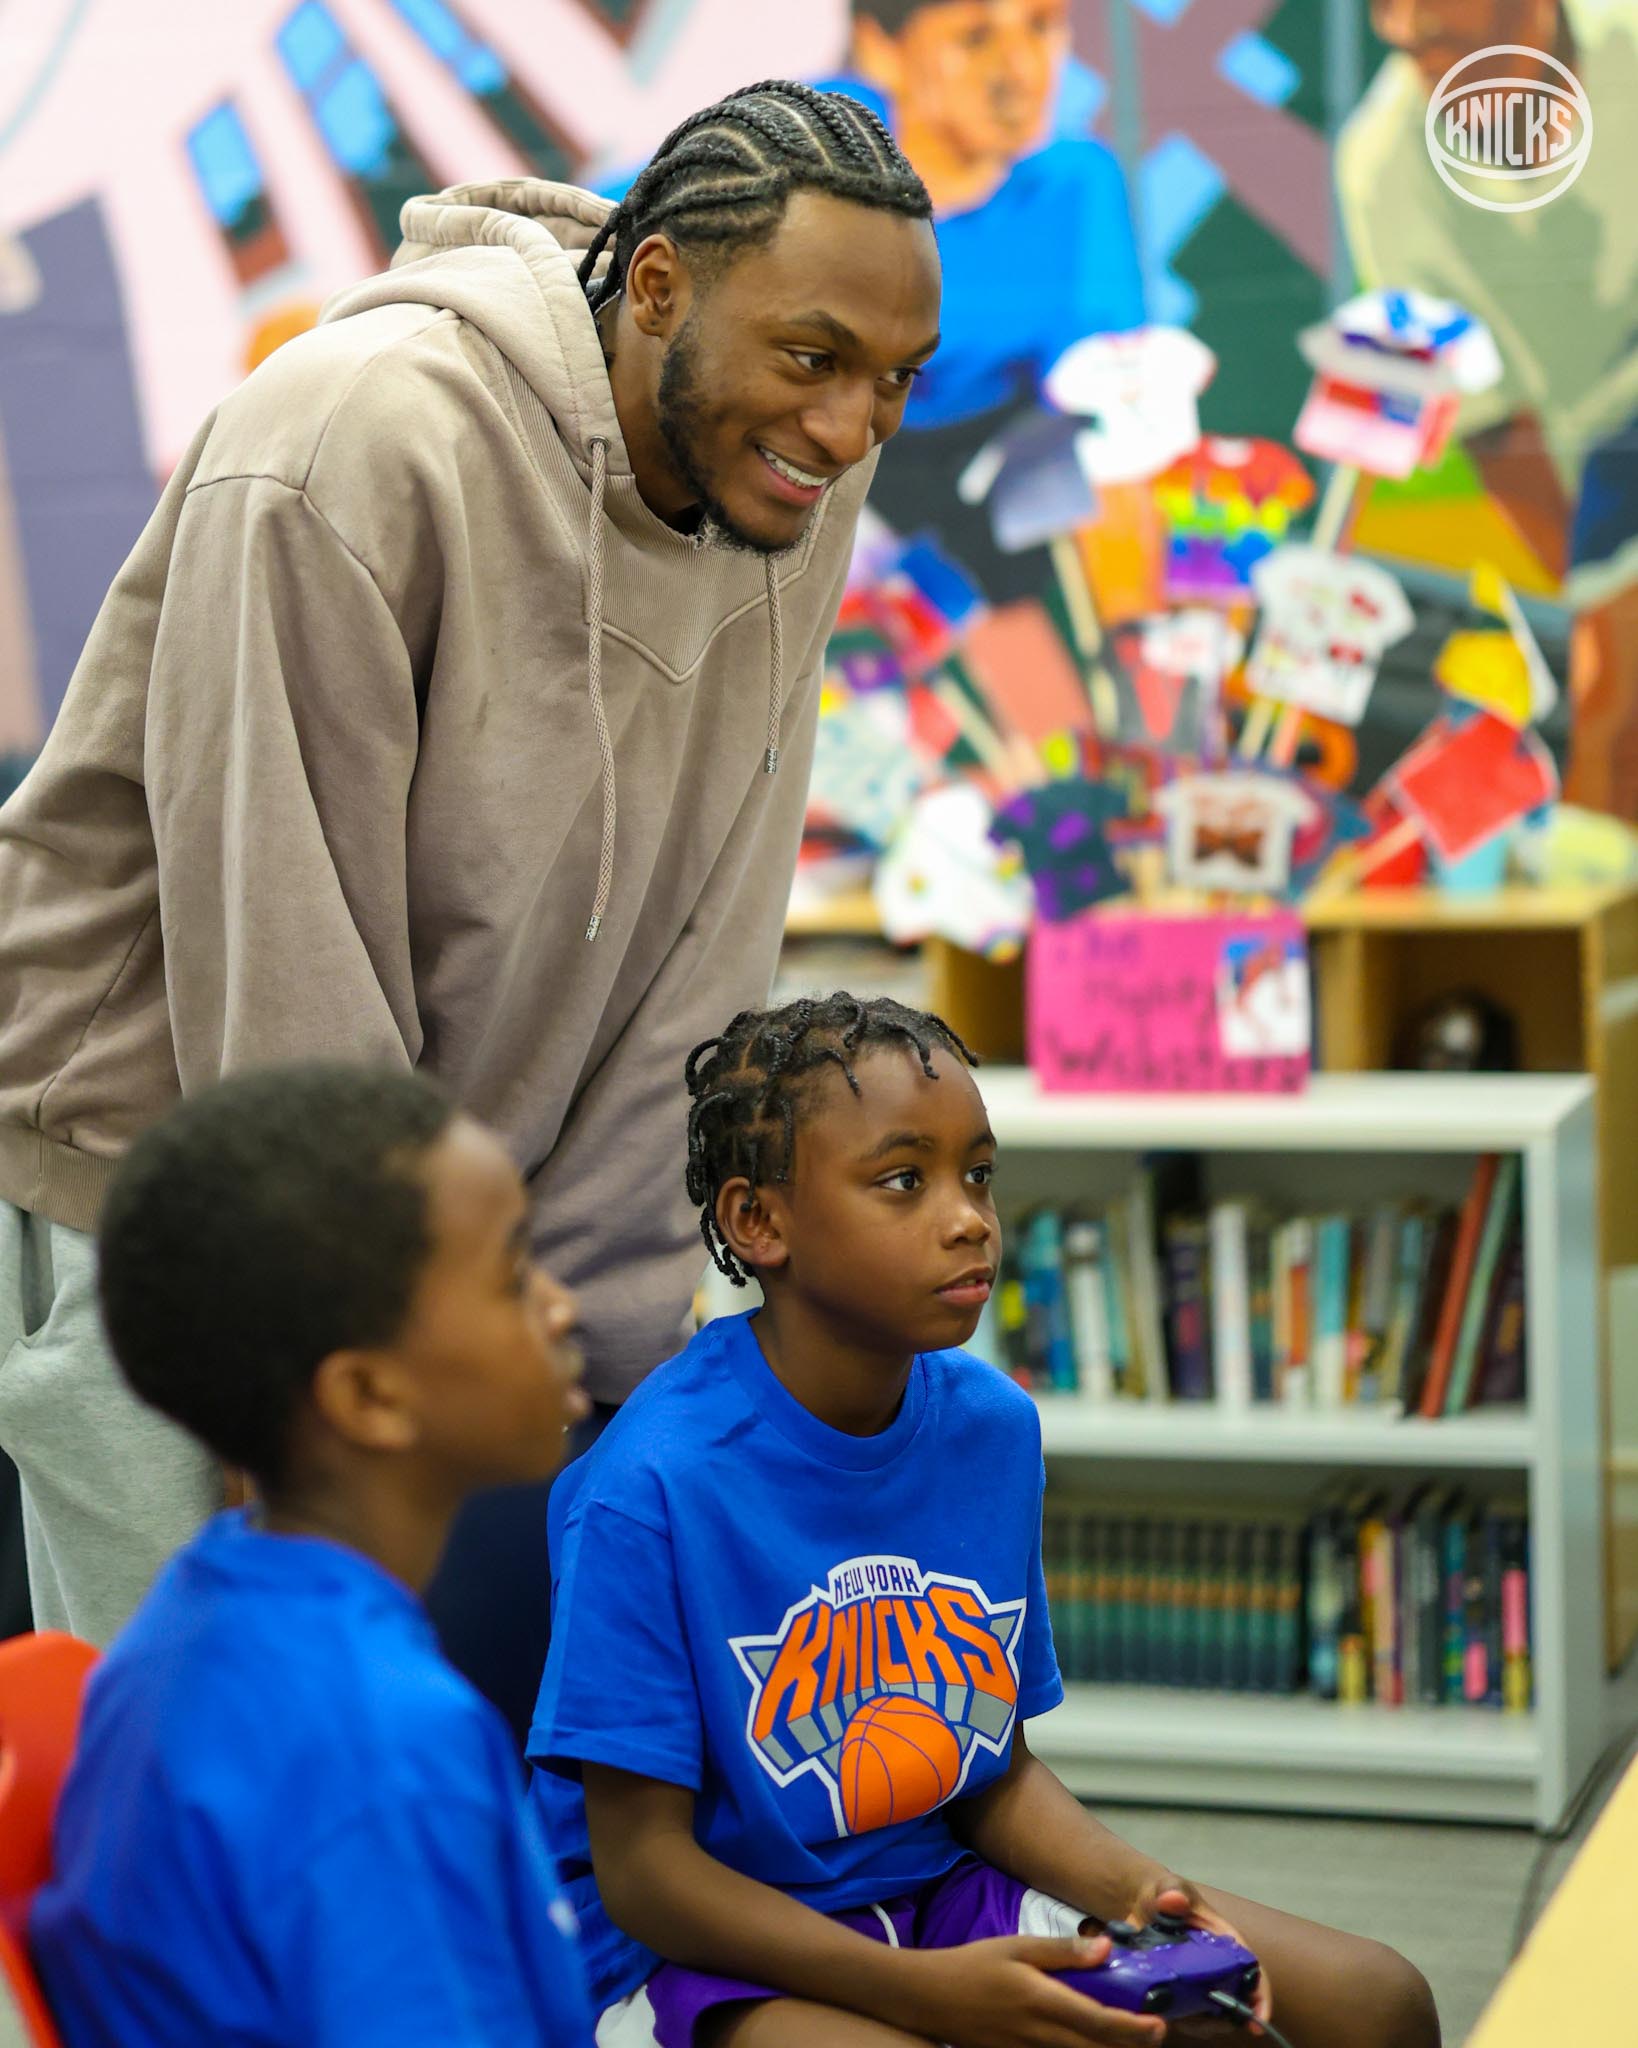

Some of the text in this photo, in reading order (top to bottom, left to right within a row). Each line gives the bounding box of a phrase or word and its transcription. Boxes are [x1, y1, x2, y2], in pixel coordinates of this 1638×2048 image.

[834, 1564, 920, 1604] NEW YORK
[752, 1586, 1018, 1743] KNICKS
